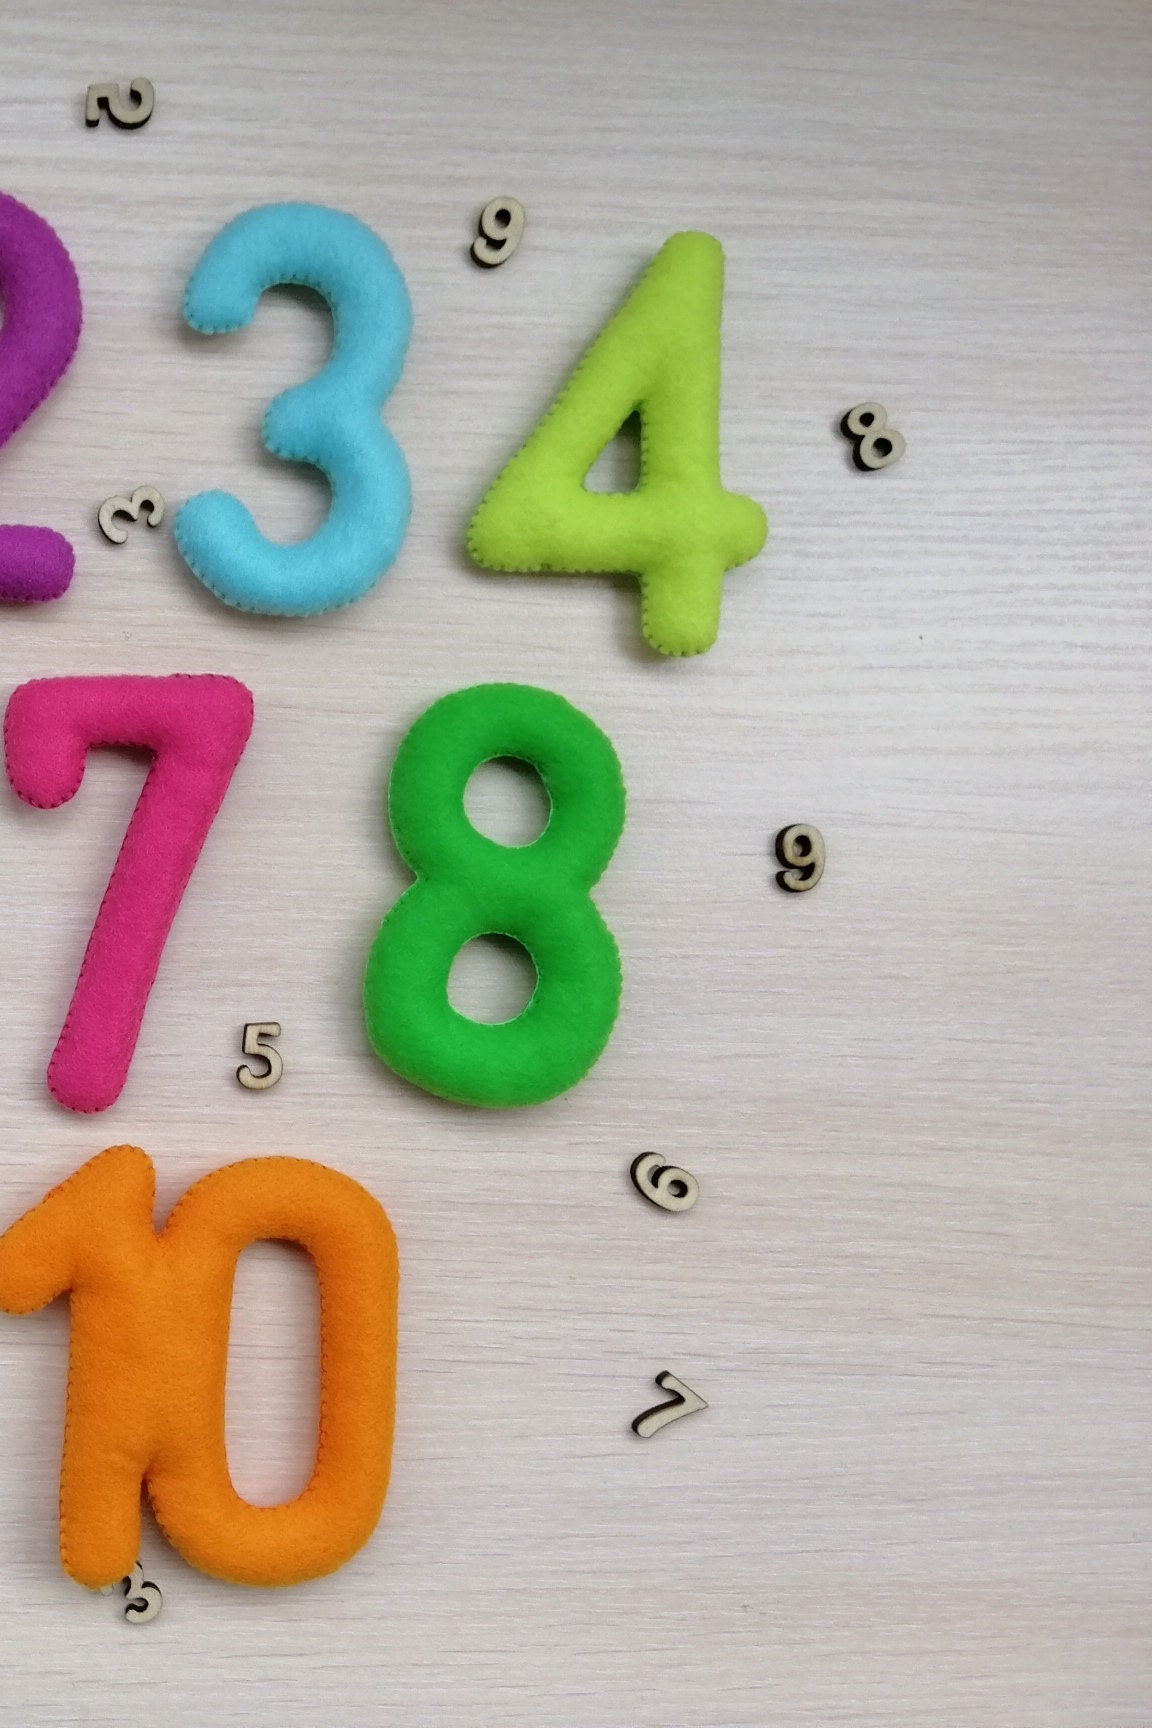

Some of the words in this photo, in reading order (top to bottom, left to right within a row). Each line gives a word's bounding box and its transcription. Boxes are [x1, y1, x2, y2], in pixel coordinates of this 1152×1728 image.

[469, 195, 526, 269] 9
[174, 202, 412, 616] 3
[467, 231, 768, 657] 4
[840, 401, 906, 472] 8
[97, 485, 165, 544] 3
[3, 673, 254, 1113] 7
[363, 682, 626, 1107] 8
[775, 823, 826, 893] 9
[235, 1022, 284, 1091] 5
[631, 1370, 709, 1439] 7
